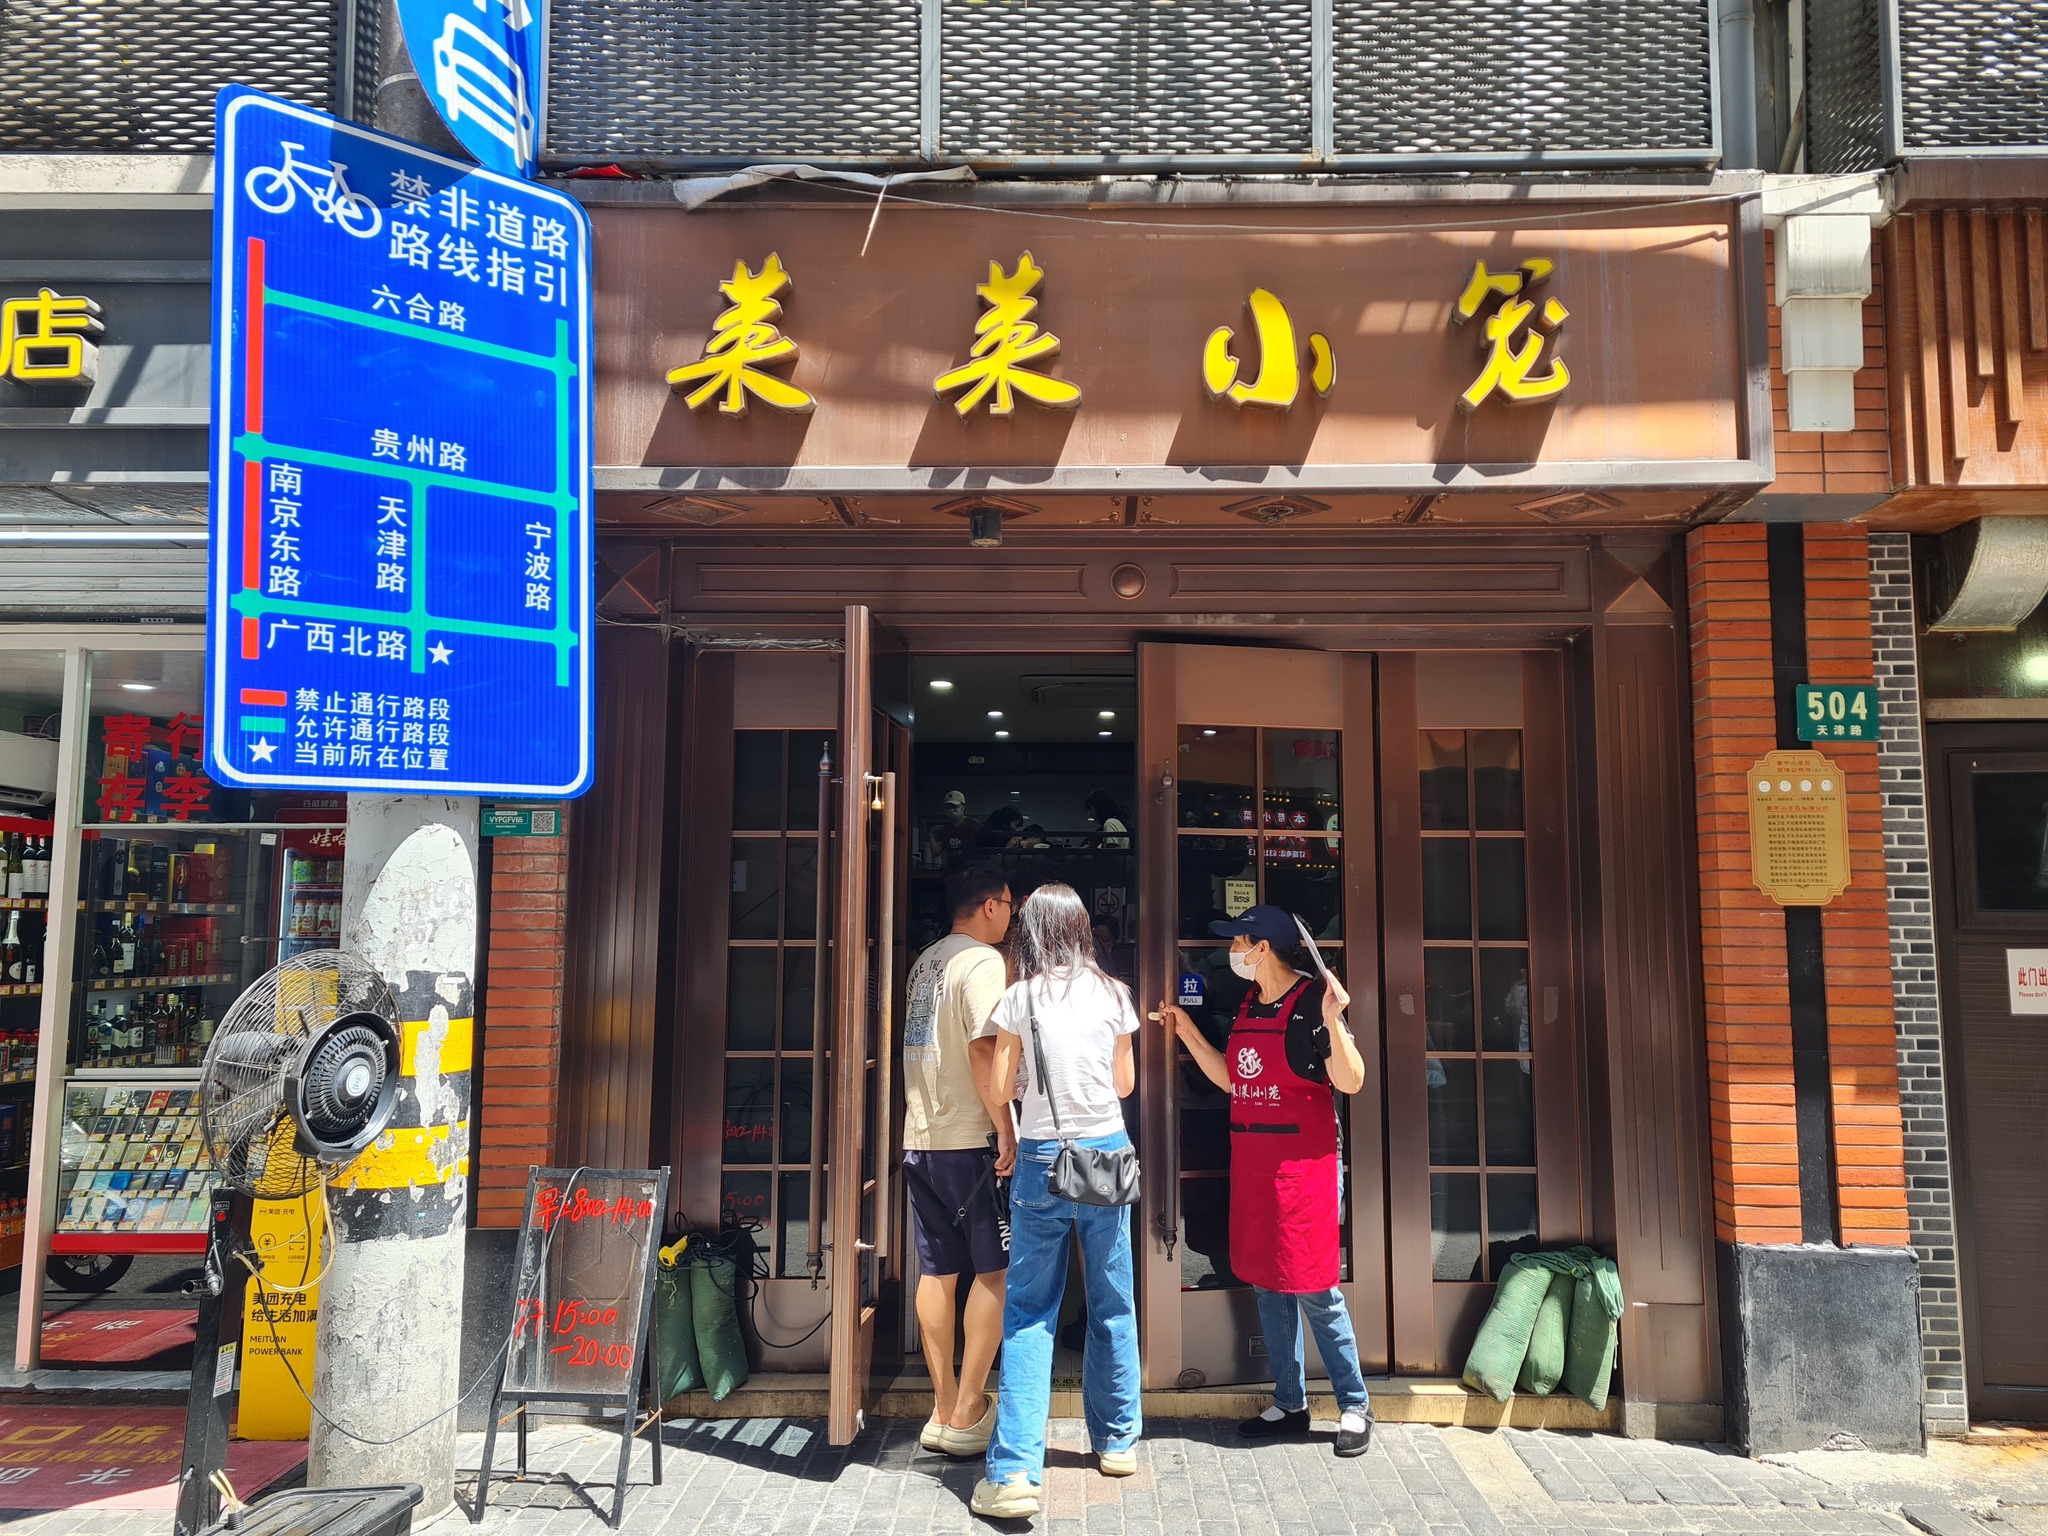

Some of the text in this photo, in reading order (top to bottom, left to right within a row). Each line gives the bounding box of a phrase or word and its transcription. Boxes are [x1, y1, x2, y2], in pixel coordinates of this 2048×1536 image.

[390, 169, 569, 261] 禁非道路
[389, 221, 568, 307] 路线指引
[371, 284, 467, 332] 六合路
[0, 287, 104, 381] 店
[666, 250, 1572, 421] 菜菜小笼
[371, 428, 467, 472] 贵州路
[267, 463, 303, 598] 南京东路
[376, 496, 407, 593] 天津路
[525, 521, 552, 611] 宁波路
[266, 618, 407, 661] 广西北路
[295, 687, 451, 721] 禁止通行路段
[1807, 691, 1868, 720] 504
[295, 715, 450, 747] 允许通行路段
[1816, 724, 1862, 736] 天津路
[295, 741, 449, 771] 当前所在位置
[1183, 978, 1198, 993] 拉
[251, 1309, 318, 1323] 给生活加满
[252, 1292, 307, 1306] 美团充电
[248, 1348, 304, 1356] POWER BANK
[249, 1335, 287, 1343] MEITUAN
[1, 1425, 185, 1444] 口味
